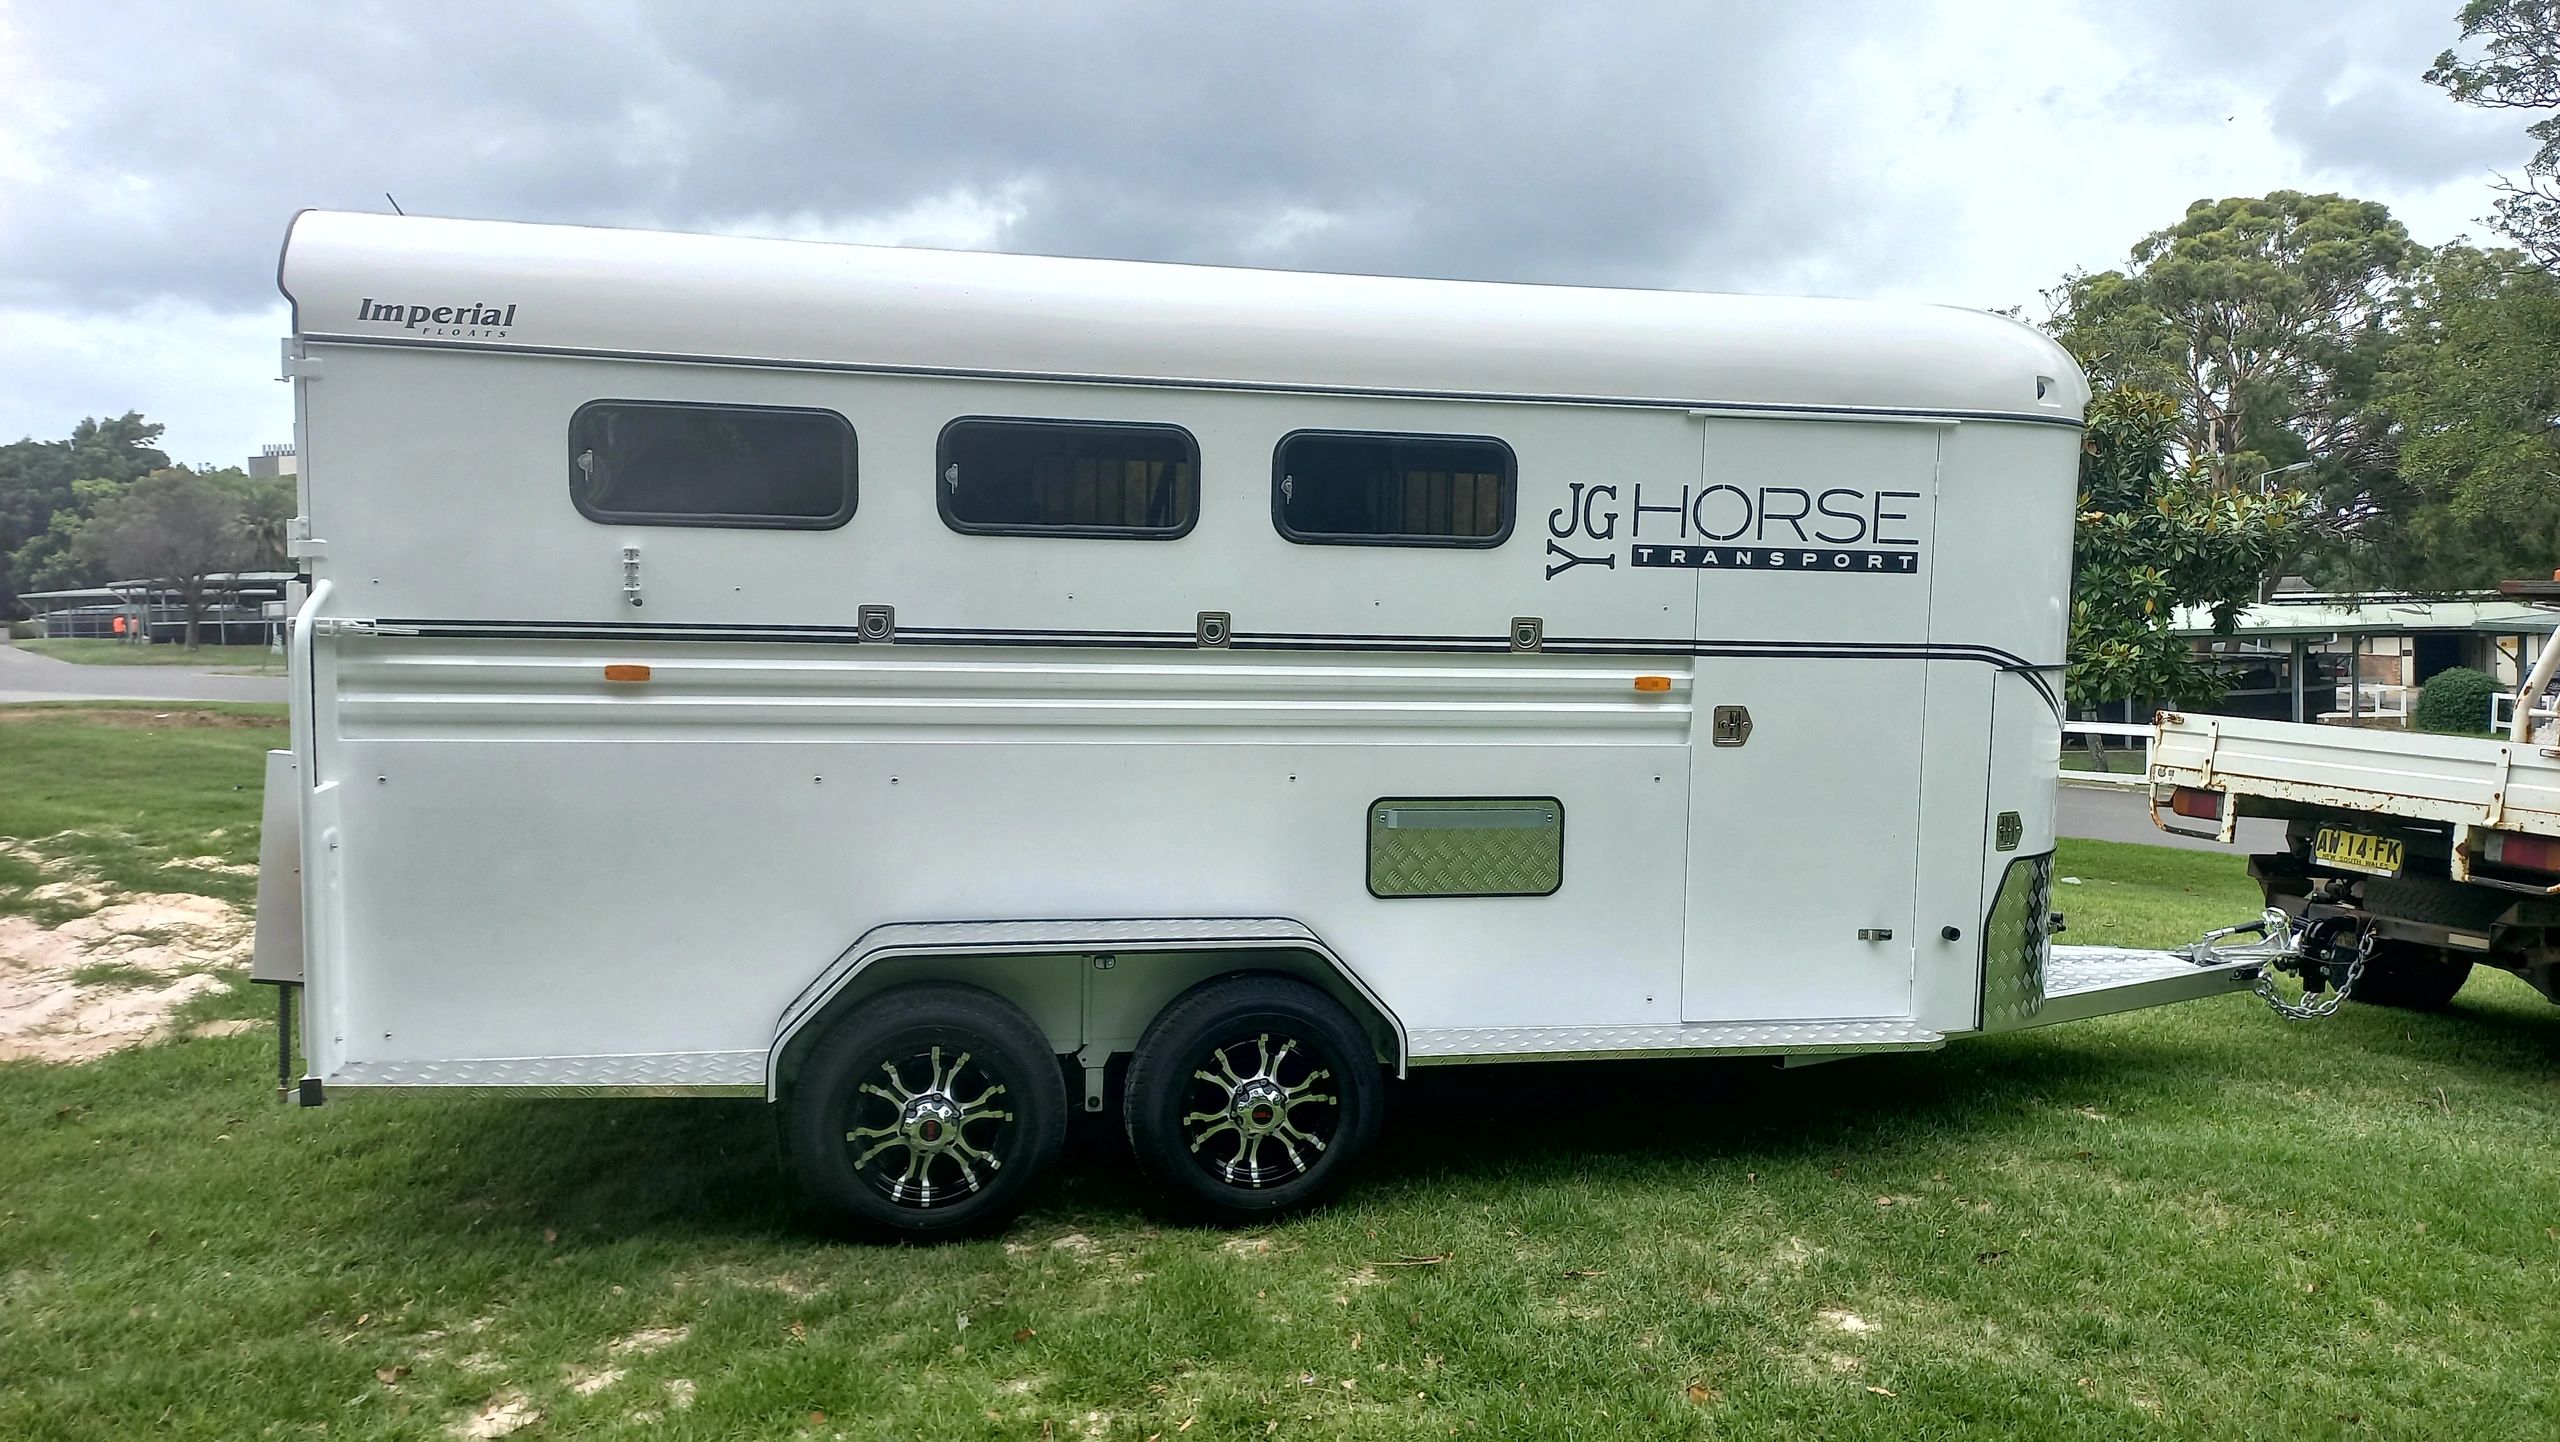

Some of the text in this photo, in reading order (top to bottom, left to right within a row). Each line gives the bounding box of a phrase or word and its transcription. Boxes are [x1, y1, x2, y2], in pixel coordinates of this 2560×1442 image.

[357, 298, 517, 329] Imperial
[422, 328, 507, 338] FLOATS
[1632, 483, 1921, 546] HORSE
[1637, 548, 1914, 570] TRANSPORT
[2339, 856, 2362, 865] SOUTH
[2365, 861, 2389, 869] WALES
